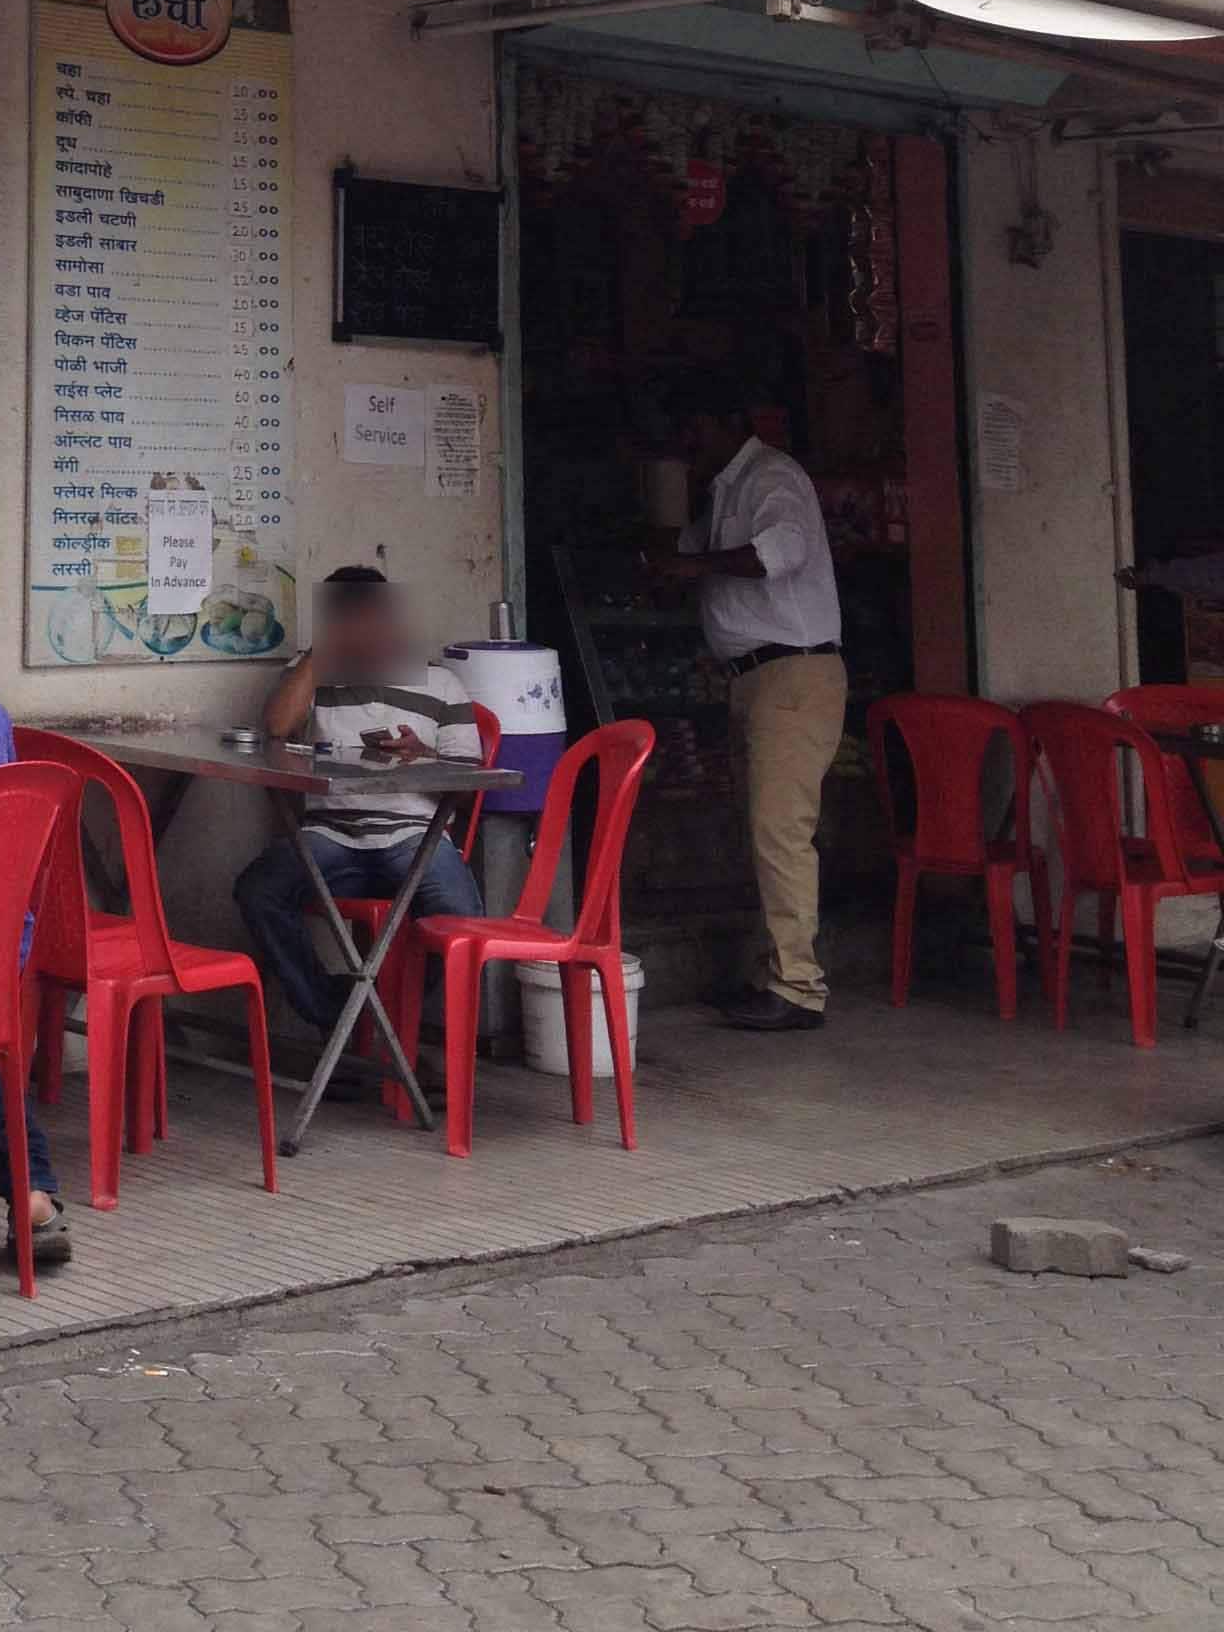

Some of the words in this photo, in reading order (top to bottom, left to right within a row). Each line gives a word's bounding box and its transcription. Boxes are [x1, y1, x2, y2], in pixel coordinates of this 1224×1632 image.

[56, 208, 93, 225] इडली
[99, 211, 136, 227] चटणी
[56, 232, 93, 248] इडली
[56, 284, 80, 297] वडा
[87, 286, 111, 298] पाव
[93, 357, 128, 374] भाजी
[368, 395, 396, 414] Self
[101, 411, 125, 424] पाव
[108, 436, 132, 448] पाव
[353, 424, 408, 446] Service
[163, 536, 195, 548] Please
[52, 558, 92, 576] लस्सी
[164, 576, 208, 588] Advance
